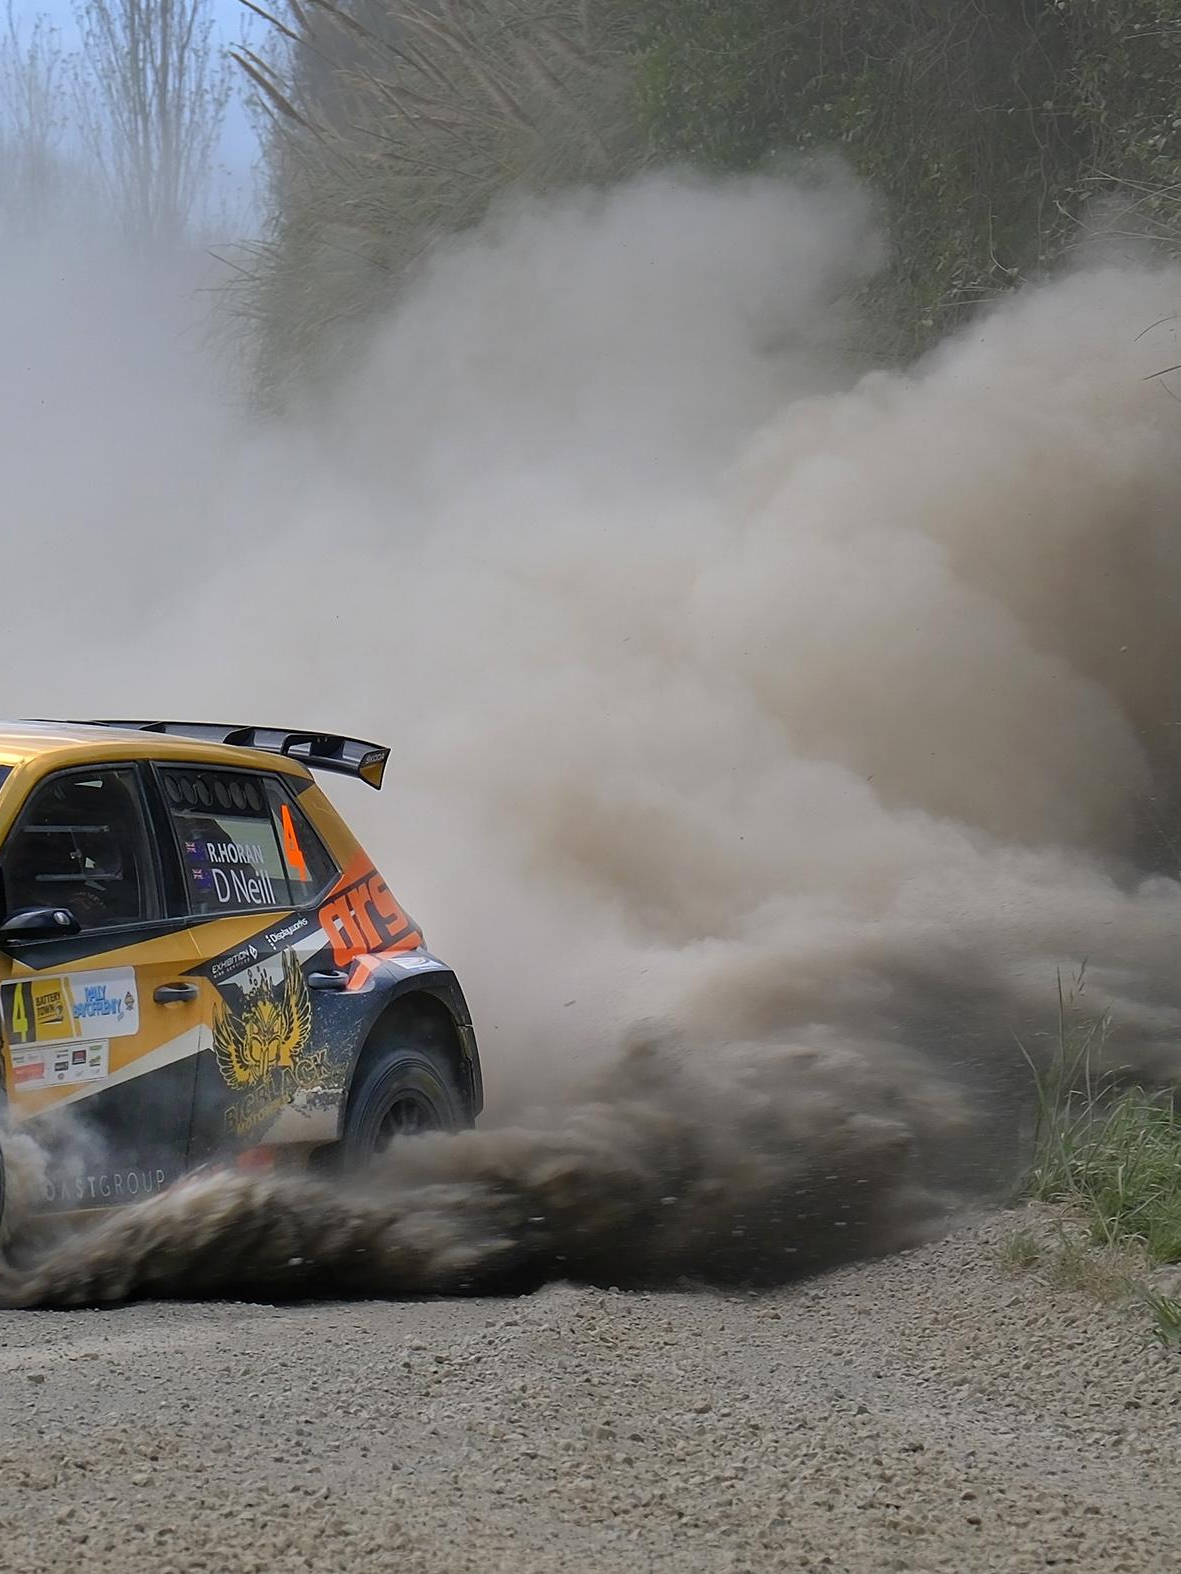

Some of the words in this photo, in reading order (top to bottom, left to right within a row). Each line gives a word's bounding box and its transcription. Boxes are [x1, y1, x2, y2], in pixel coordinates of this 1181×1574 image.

[206, 842, 265, 864] R.HORAN
[280, 803, 308, 883] 4
[230, 869, 277, 905] Neill
[269, 918, 308, 943] Displayworks
[211, 949, 250, 974] EXHIBITION
[36, 991, 60, 1007] BATTERY
[84, 985, 107, 1001] RALLY
[12, 982, 29, 1043] 4
[43, 1169, 166, 1201] OASTGROUP
